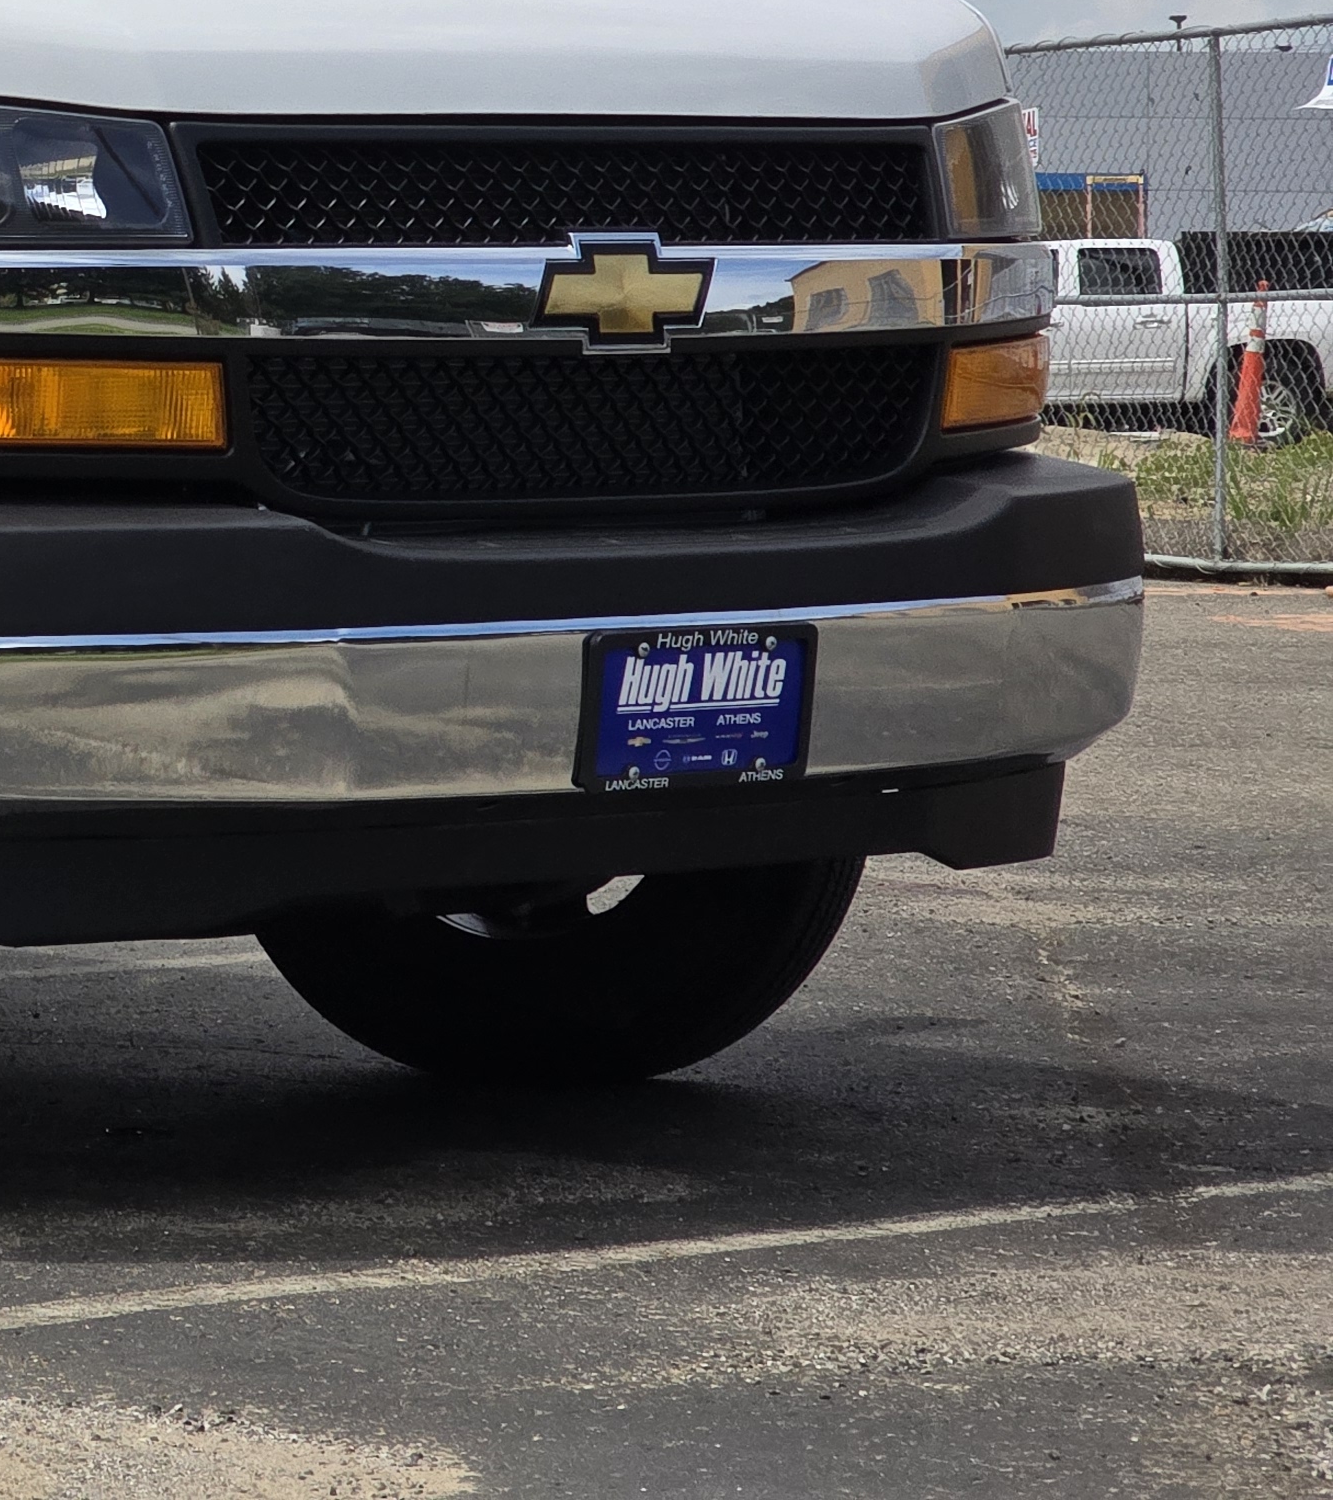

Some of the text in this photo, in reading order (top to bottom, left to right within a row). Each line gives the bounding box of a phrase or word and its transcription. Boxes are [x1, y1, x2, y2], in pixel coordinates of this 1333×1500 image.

[656, 629, 759, 651] Hugh White
[618, 651, 787, 712] Hugh White
[628, 713, 762, 731] LANCASTER ATHENS
[605, 769, 783, 792] LANCASTER ATHENS
